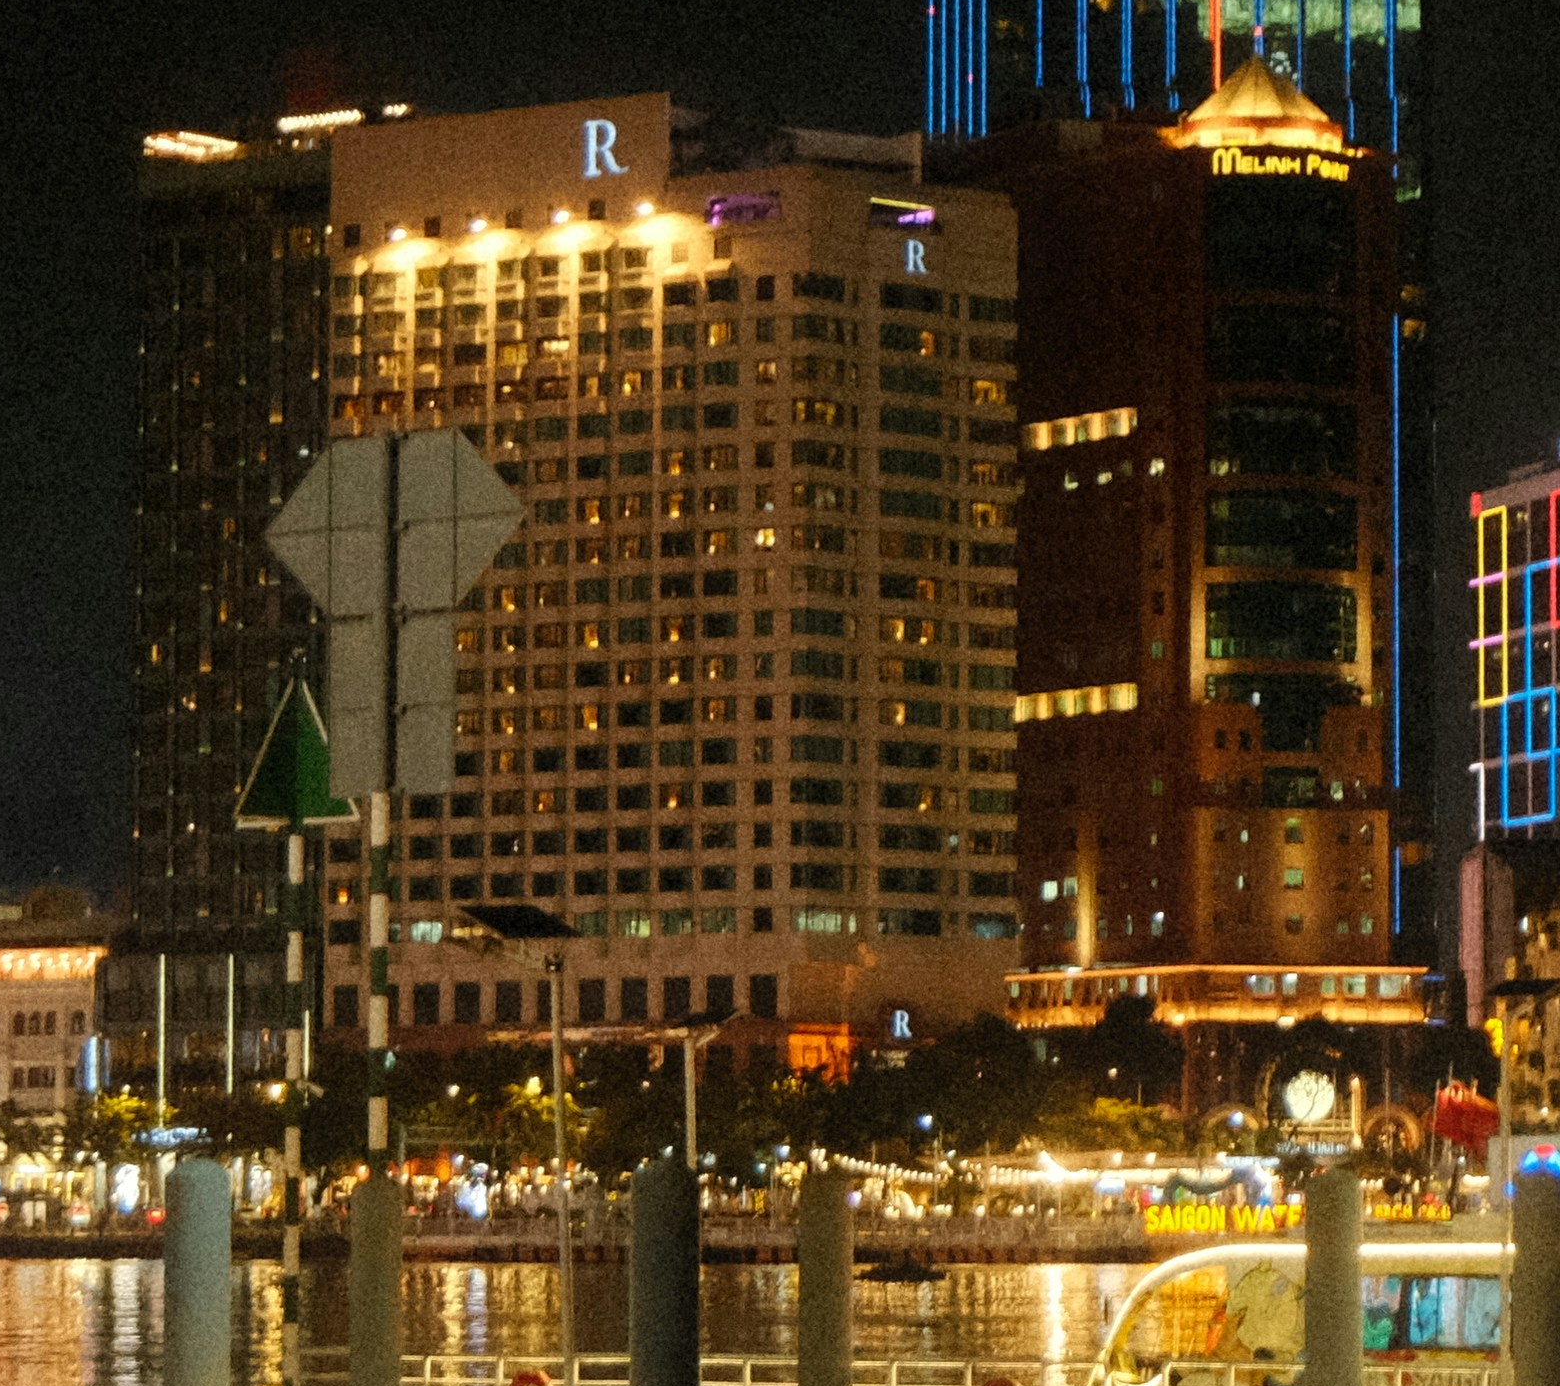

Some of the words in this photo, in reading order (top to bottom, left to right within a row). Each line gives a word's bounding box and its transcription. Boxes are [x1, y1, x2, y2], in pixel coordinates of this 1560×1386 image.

[583, 118, 630, 178] R
[904, 238, 929, 274] R
[891, 1009, 913, 1039] R
[1145, 1205, 1225, 1231] SAIGON
[1233, 1204, 1303, 1231] WATE
